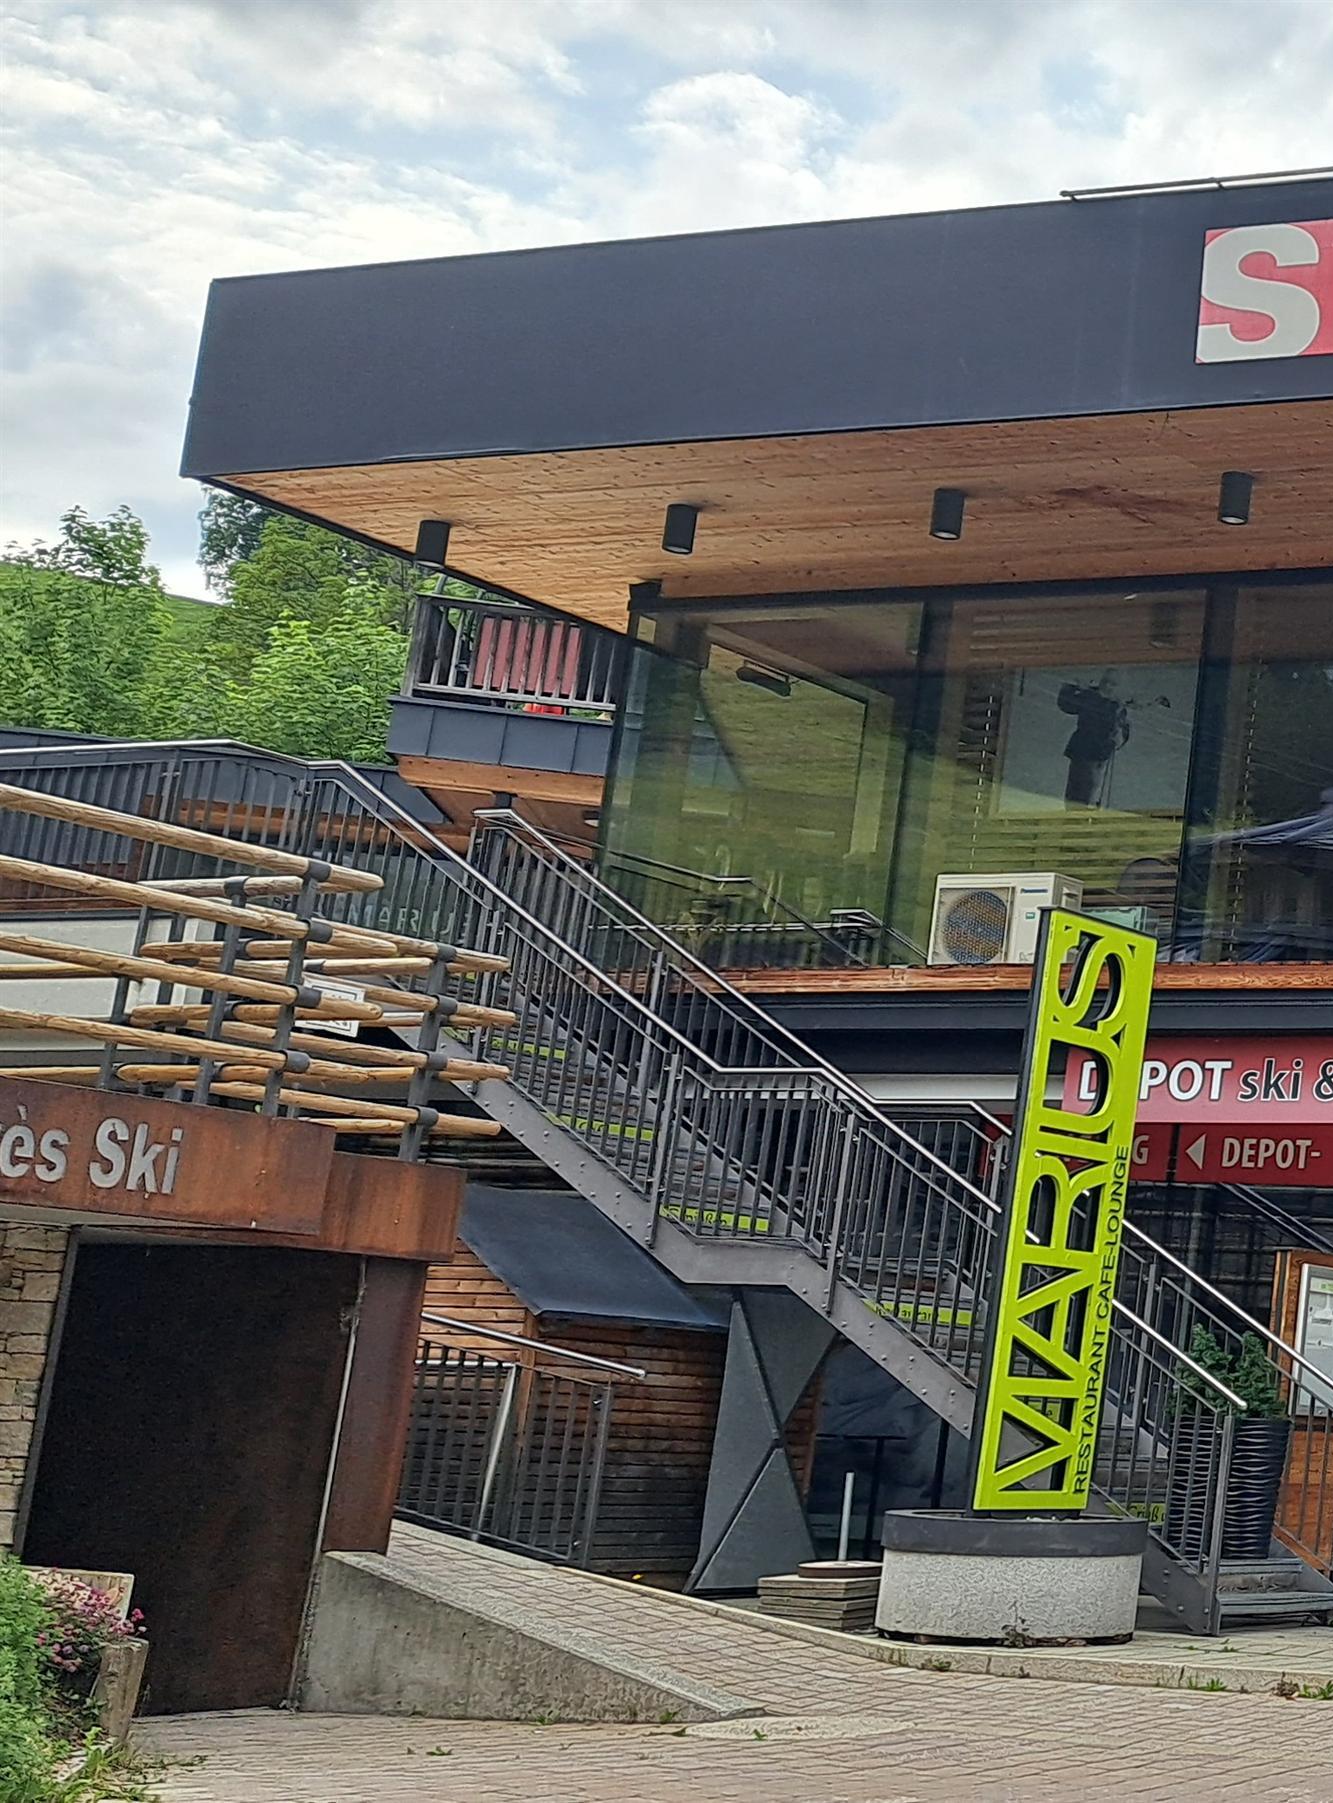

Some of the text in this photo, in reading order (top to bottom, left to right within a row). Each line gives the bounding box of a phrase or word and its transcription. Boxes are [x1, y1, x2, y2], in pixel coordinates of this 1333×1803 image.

[1079, 1059, 1232, 1101] DPOT
[1237, 1057, 1303, 1102] ski
[89, 1116, 185, 1196] Ski
[990, 922, 1143, 1506] MARIUS
[1220, 1137, 1322, 1170] DEPOT-
[1096, 1145, 1129, 1319] CAFE-LOUNGE
[1072, 1324, 1106, 1494] RESTAURANT
